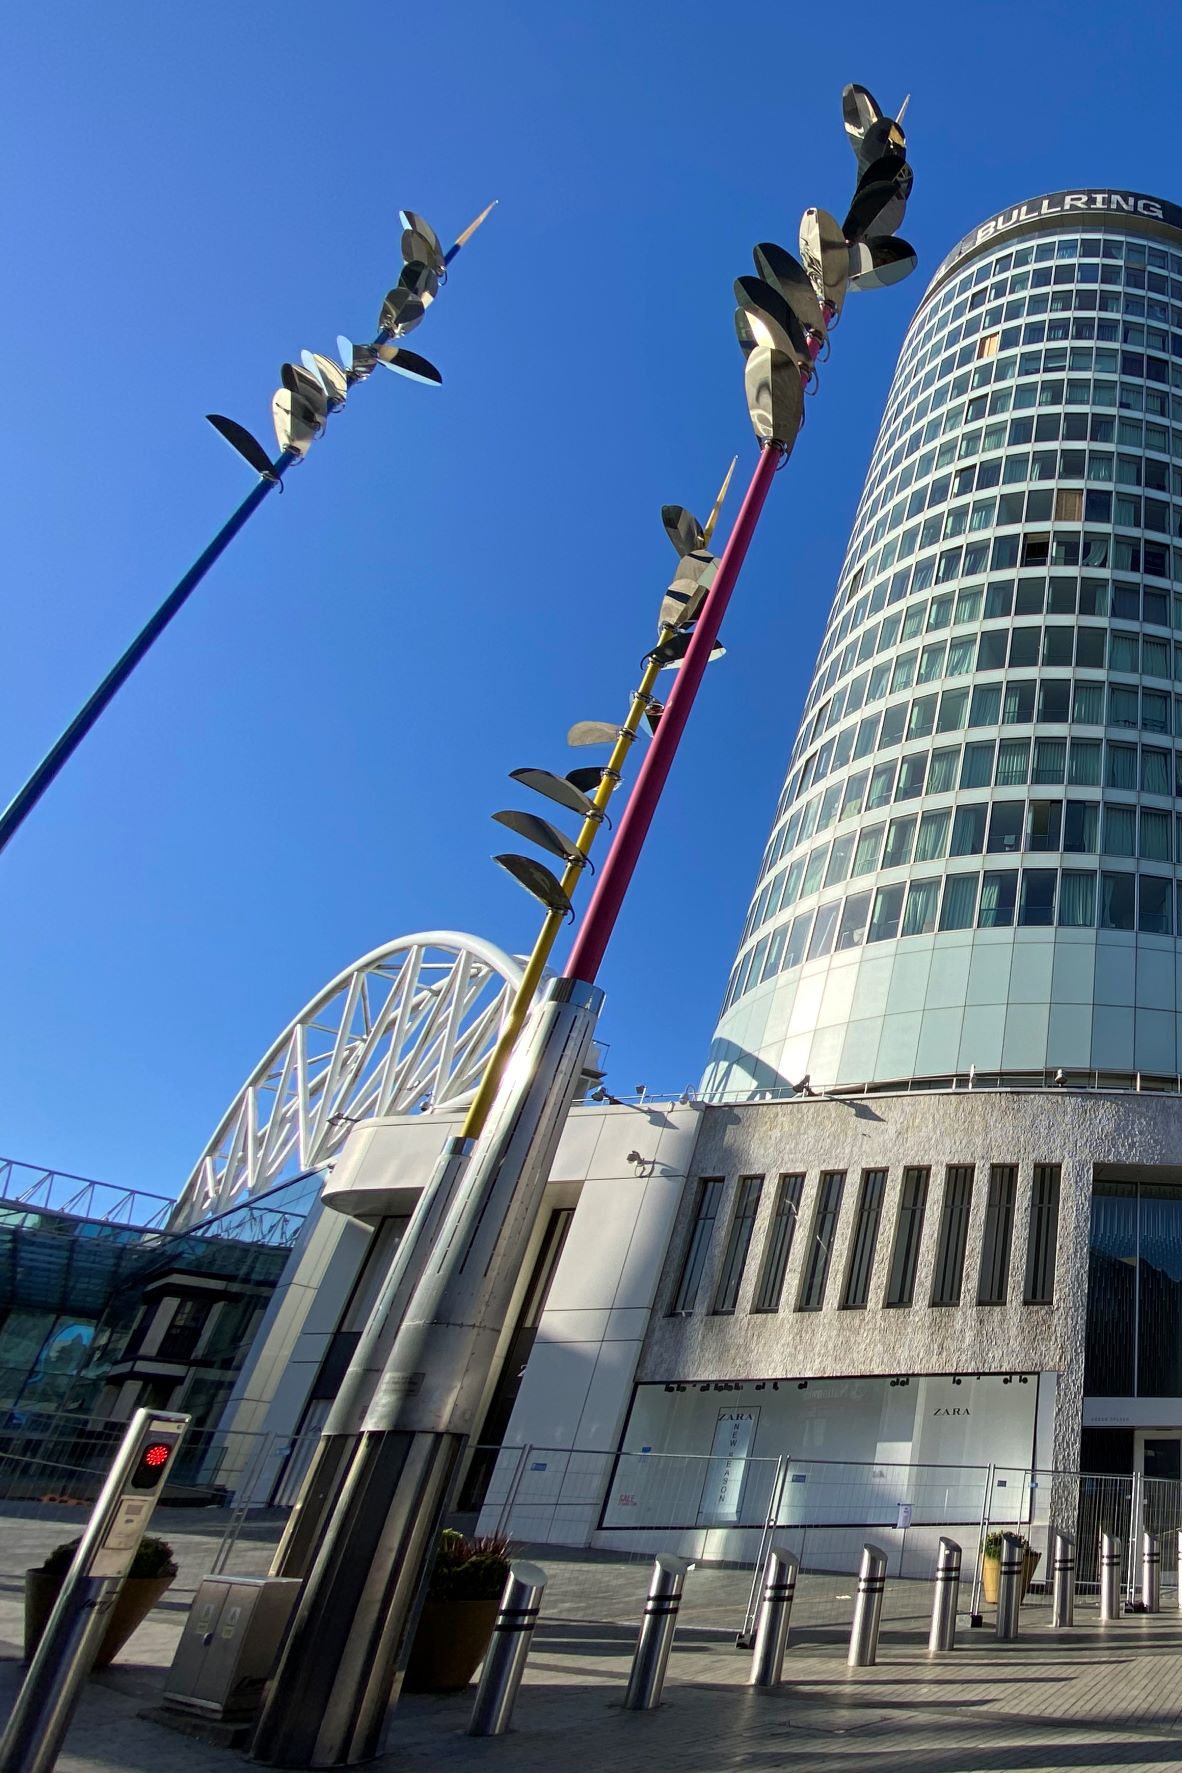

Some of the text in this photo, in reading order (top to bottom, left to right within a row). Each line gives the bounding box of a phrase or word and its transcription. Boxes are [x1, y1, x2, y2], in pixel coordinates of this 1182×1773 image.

[976, 193, 1164, 245] BULLRING
[718, 1413, 753, 1421] ZARA
[933, 1408, 971, 1416] ZARA
[730, 1423, 740, 1447] NEW
